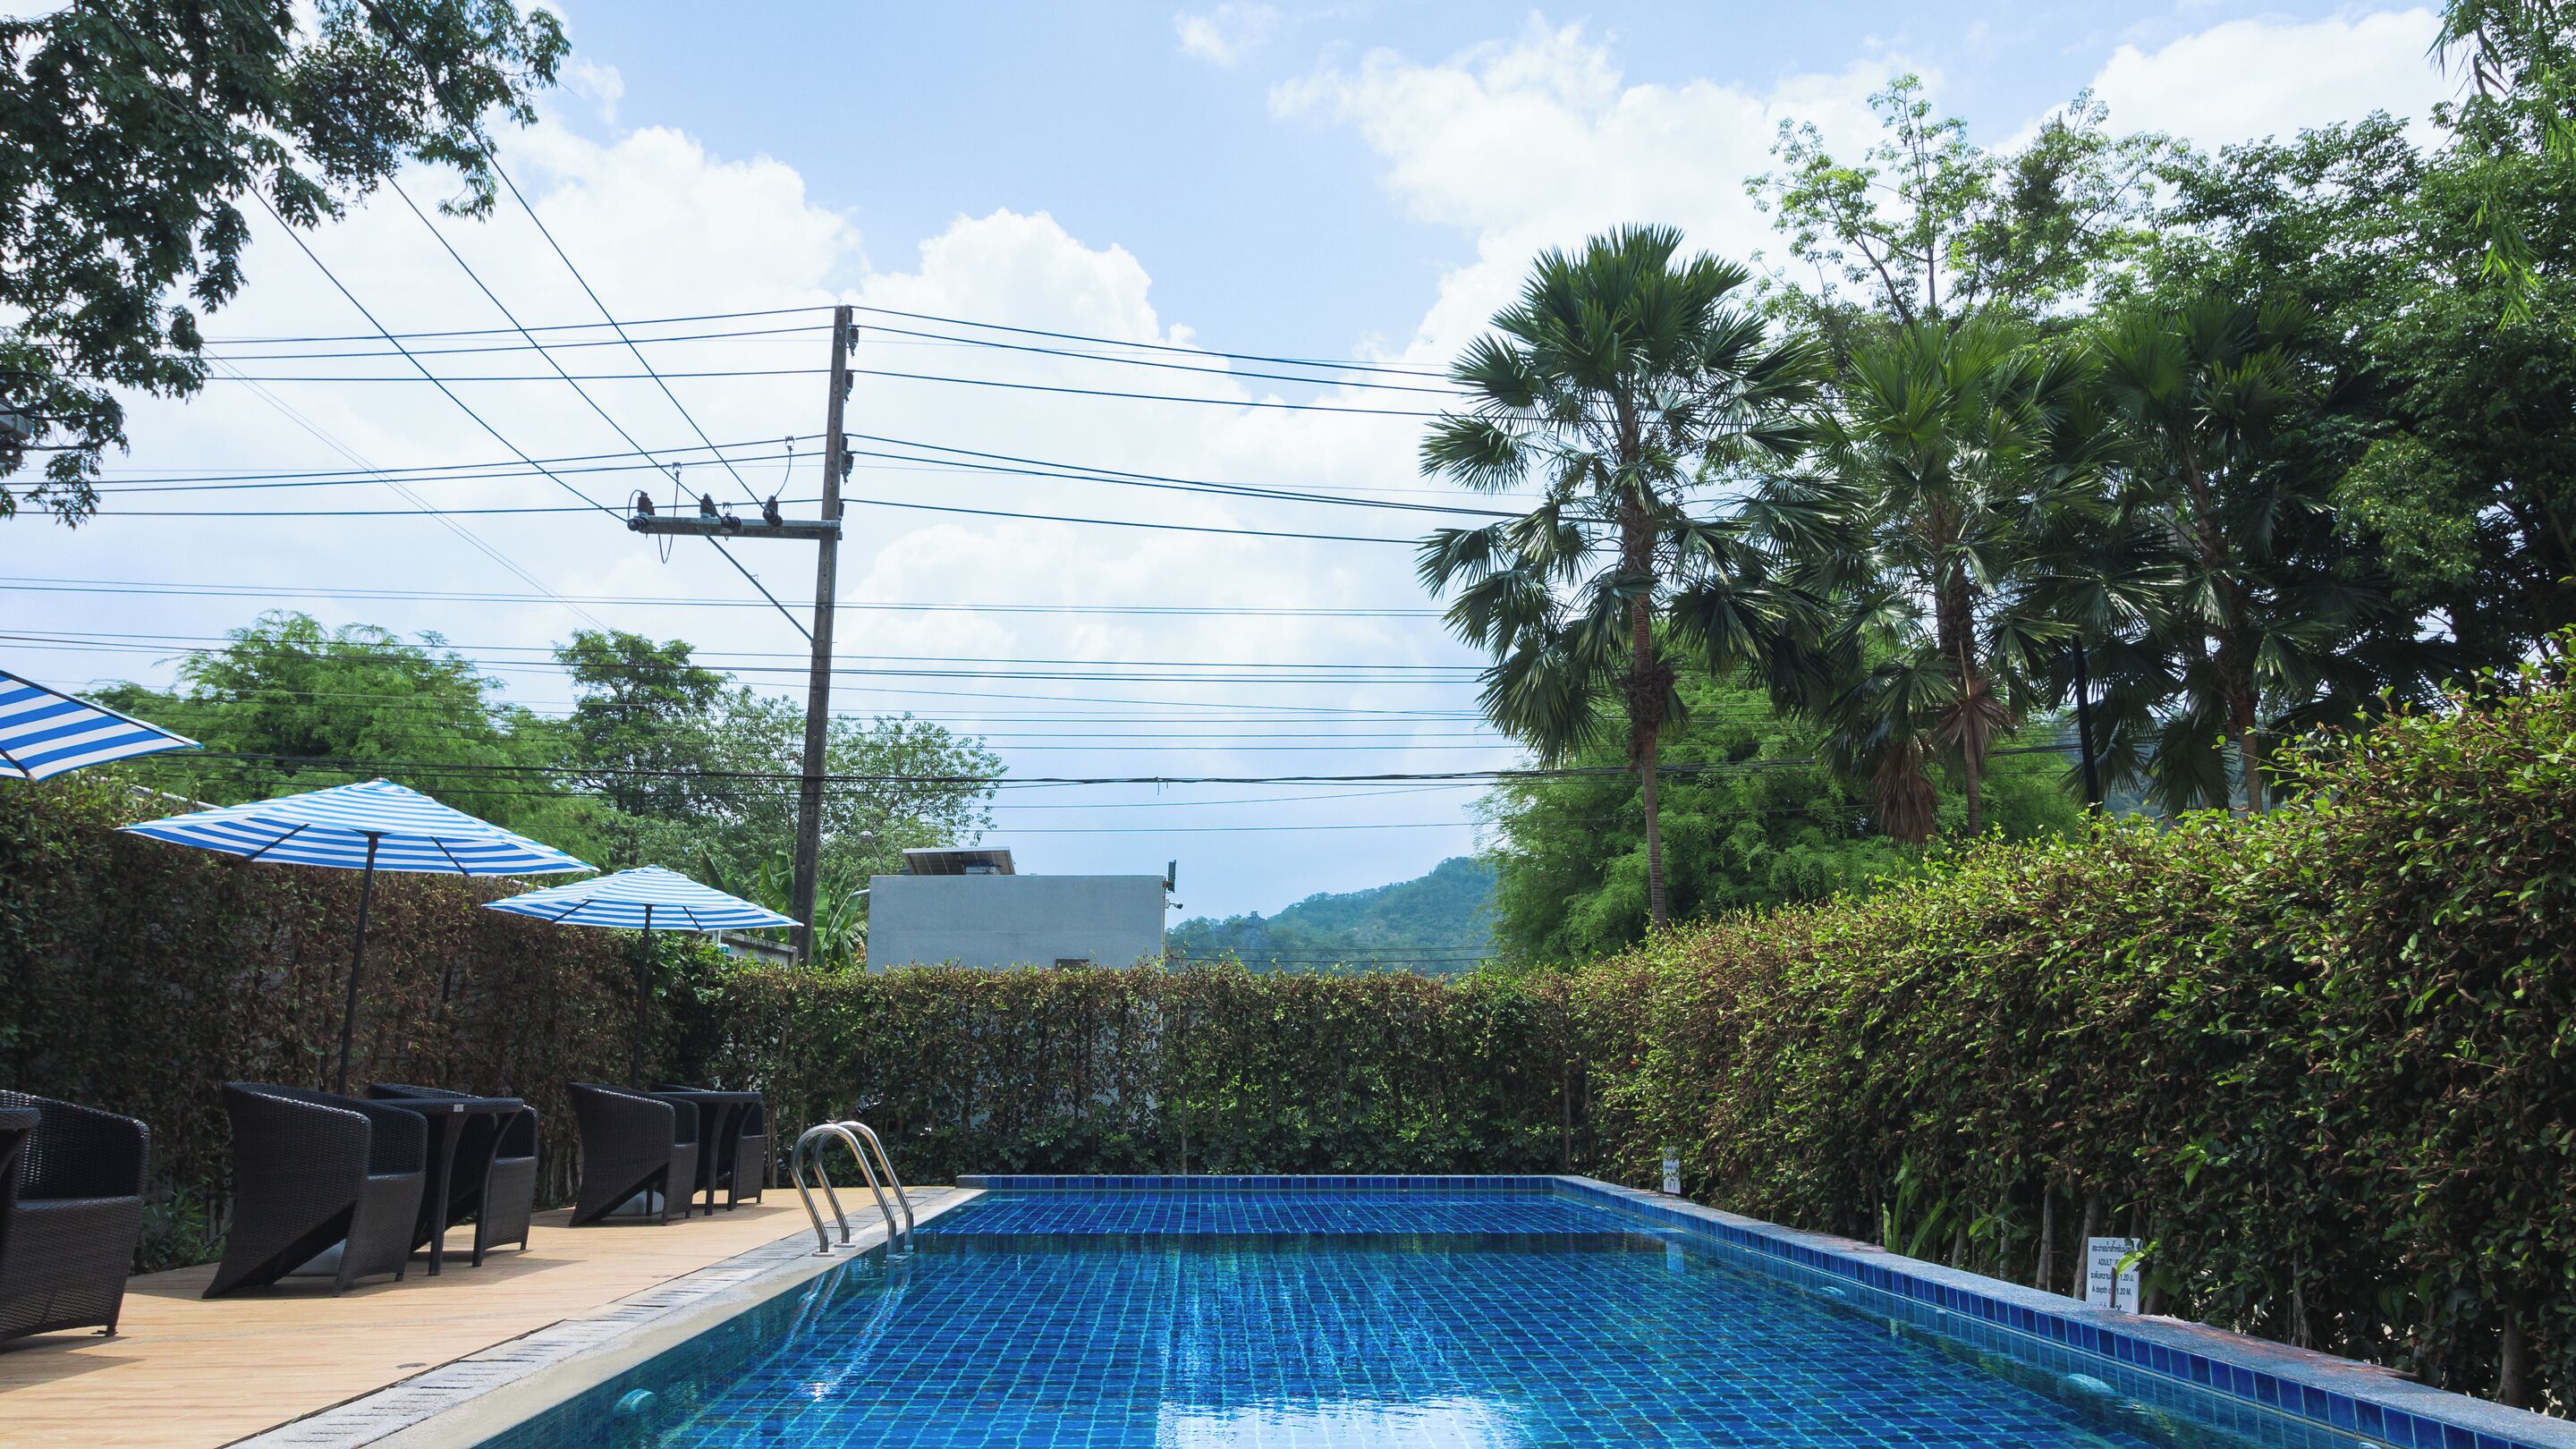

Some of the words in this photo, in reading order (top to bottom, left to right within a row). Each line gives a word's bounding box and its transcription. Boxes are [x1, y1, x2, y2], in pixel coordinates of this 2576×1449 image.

[2098, 1258, 2112, 1266] ADULT
[2120, 1274, 2129, 1282] 1.20
[2096, 1286, 2107, 1294] depth
